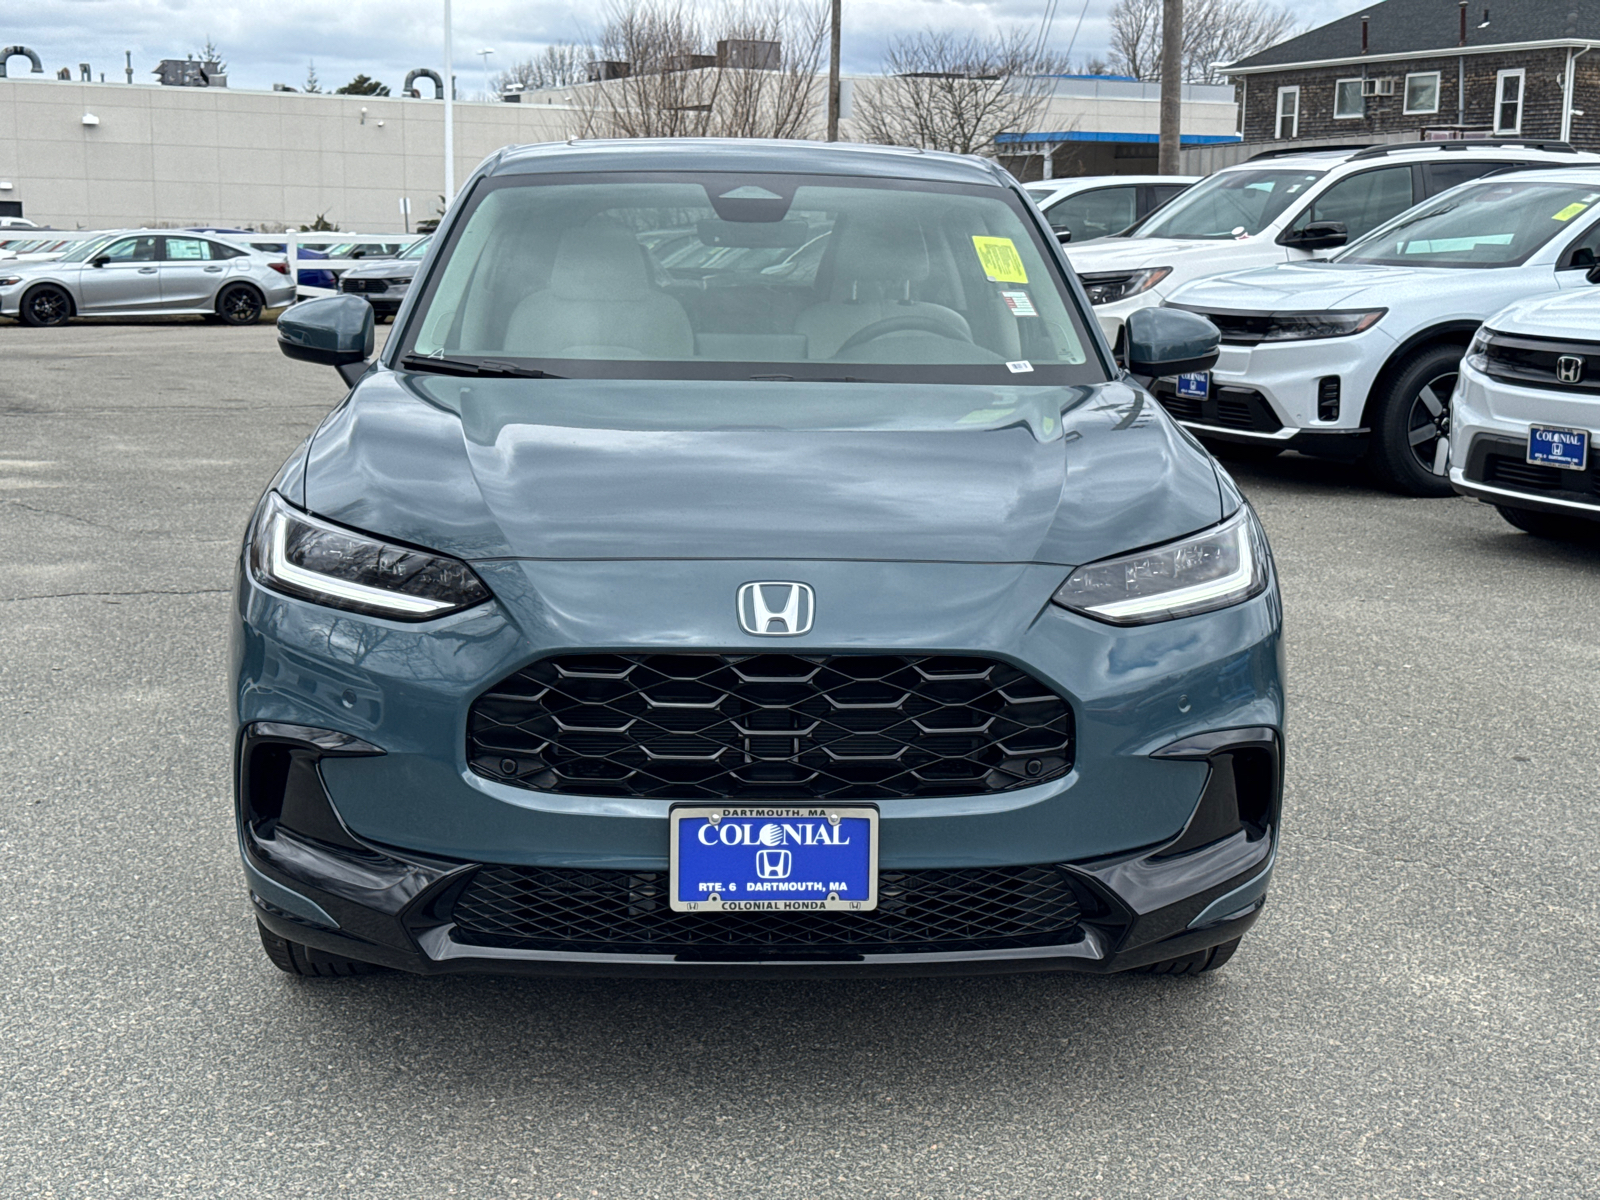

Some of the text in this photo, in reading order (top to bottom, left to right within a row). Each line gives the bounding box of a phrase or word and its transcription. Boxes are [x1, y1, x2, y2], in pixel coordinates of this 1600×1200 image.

[1536, 431, 1581, 445] COLONIAL
[722, 809, 827, 817] DARTMOUTH, MA
[697, 823, 851, 847] COLONIAL
[698, 882, 848, 892] RTE. 6 DARTMOUTH, MA
[721, 901, 827, 911] COLONIAL HONDA
